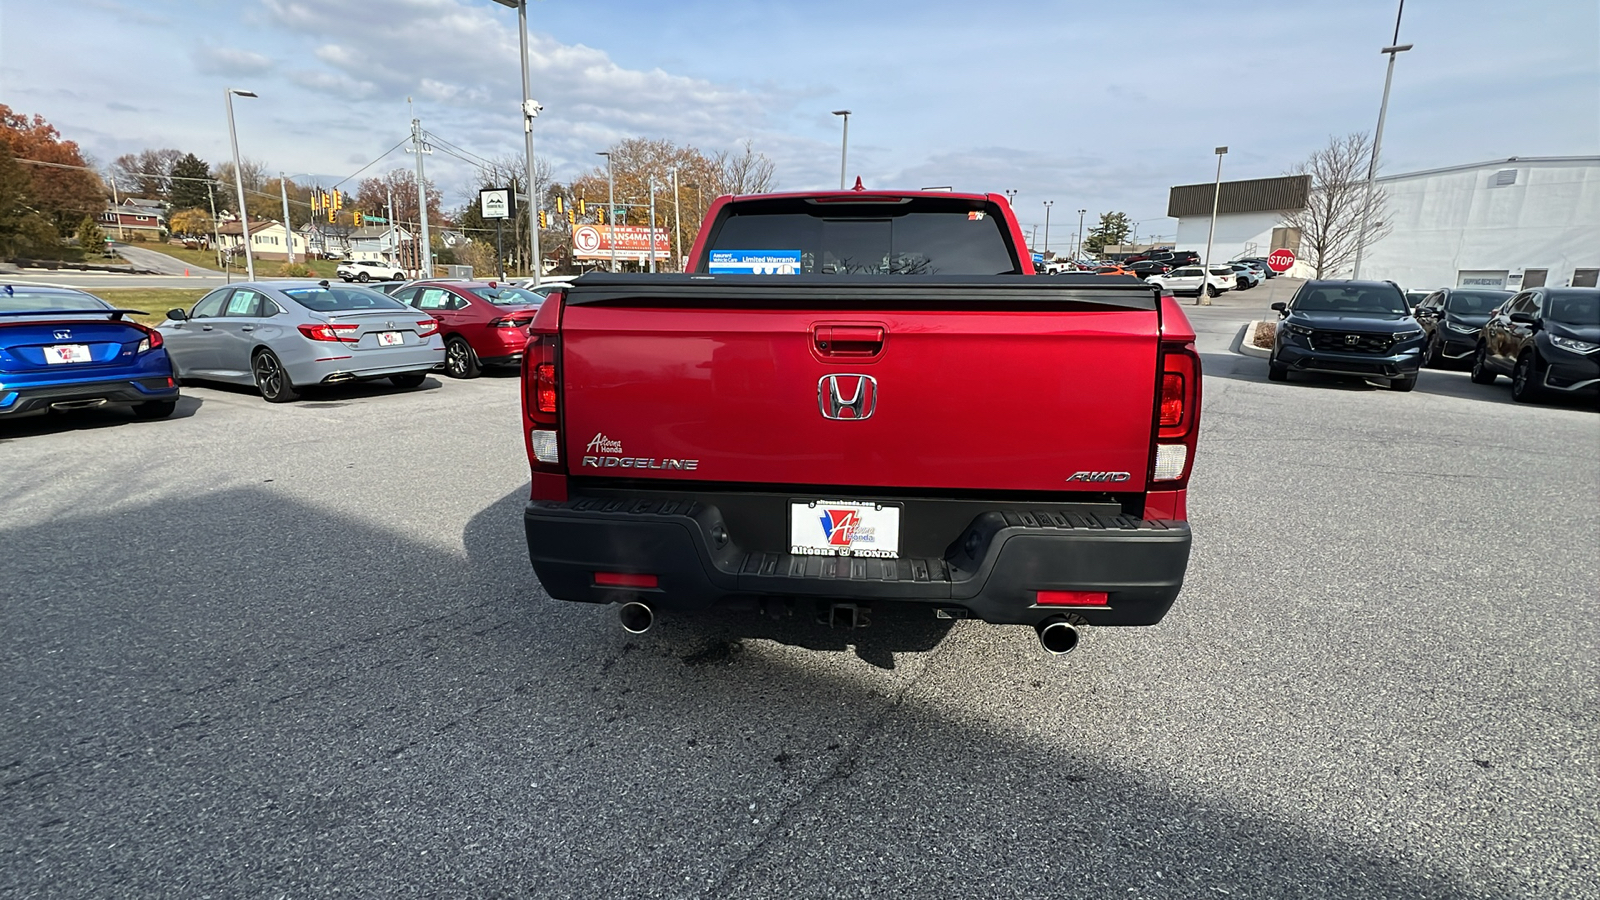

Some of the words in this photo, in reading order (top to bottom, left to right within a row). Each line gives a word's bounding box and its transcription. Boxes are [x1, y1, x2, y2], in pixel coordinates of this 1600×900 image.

[602, 233, 668, 241] TRANS4MATON
[1270, 255, 1294, 266] STOP
[582, 456, 699, 470] RIDGELINE
[1065, 471, 1131, 482] AWD
[847, 533, 876, 541] Honda
[790, 546, 836, 556] Altoona
[853, 549, 900, 559] HONDA
